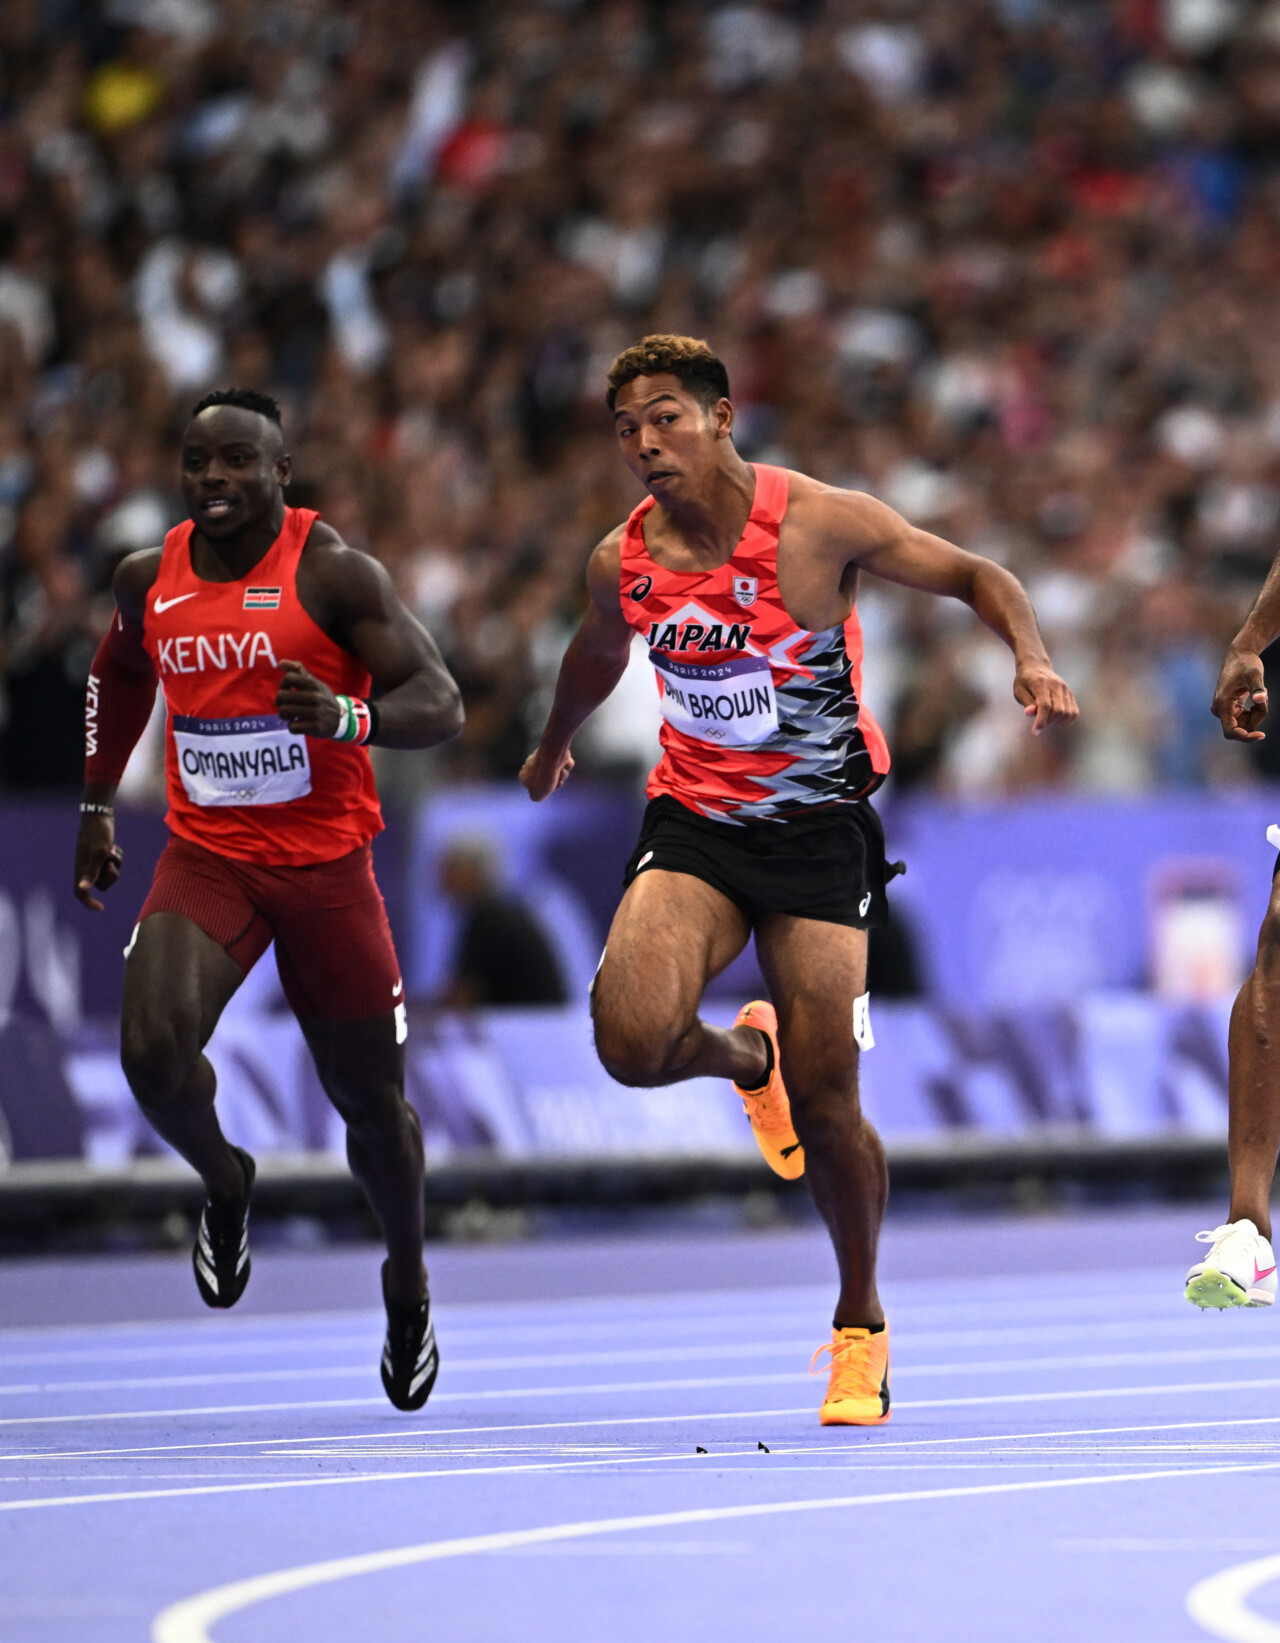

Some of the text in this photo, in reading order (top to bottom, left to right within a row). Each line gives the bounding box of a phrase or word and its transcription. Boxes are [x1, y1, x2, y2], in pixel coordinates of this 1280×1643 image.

[157, 631, 278, 675] KENYA
[644, 622, 753, 652] JAPAN
[669, 662, 732, 677] PARIS 2024
[687, 685, 772, 721] BROWN
[199, 720, 266, 732] PARIS 2024
[182, 743, 306, 779] OMANYALA
